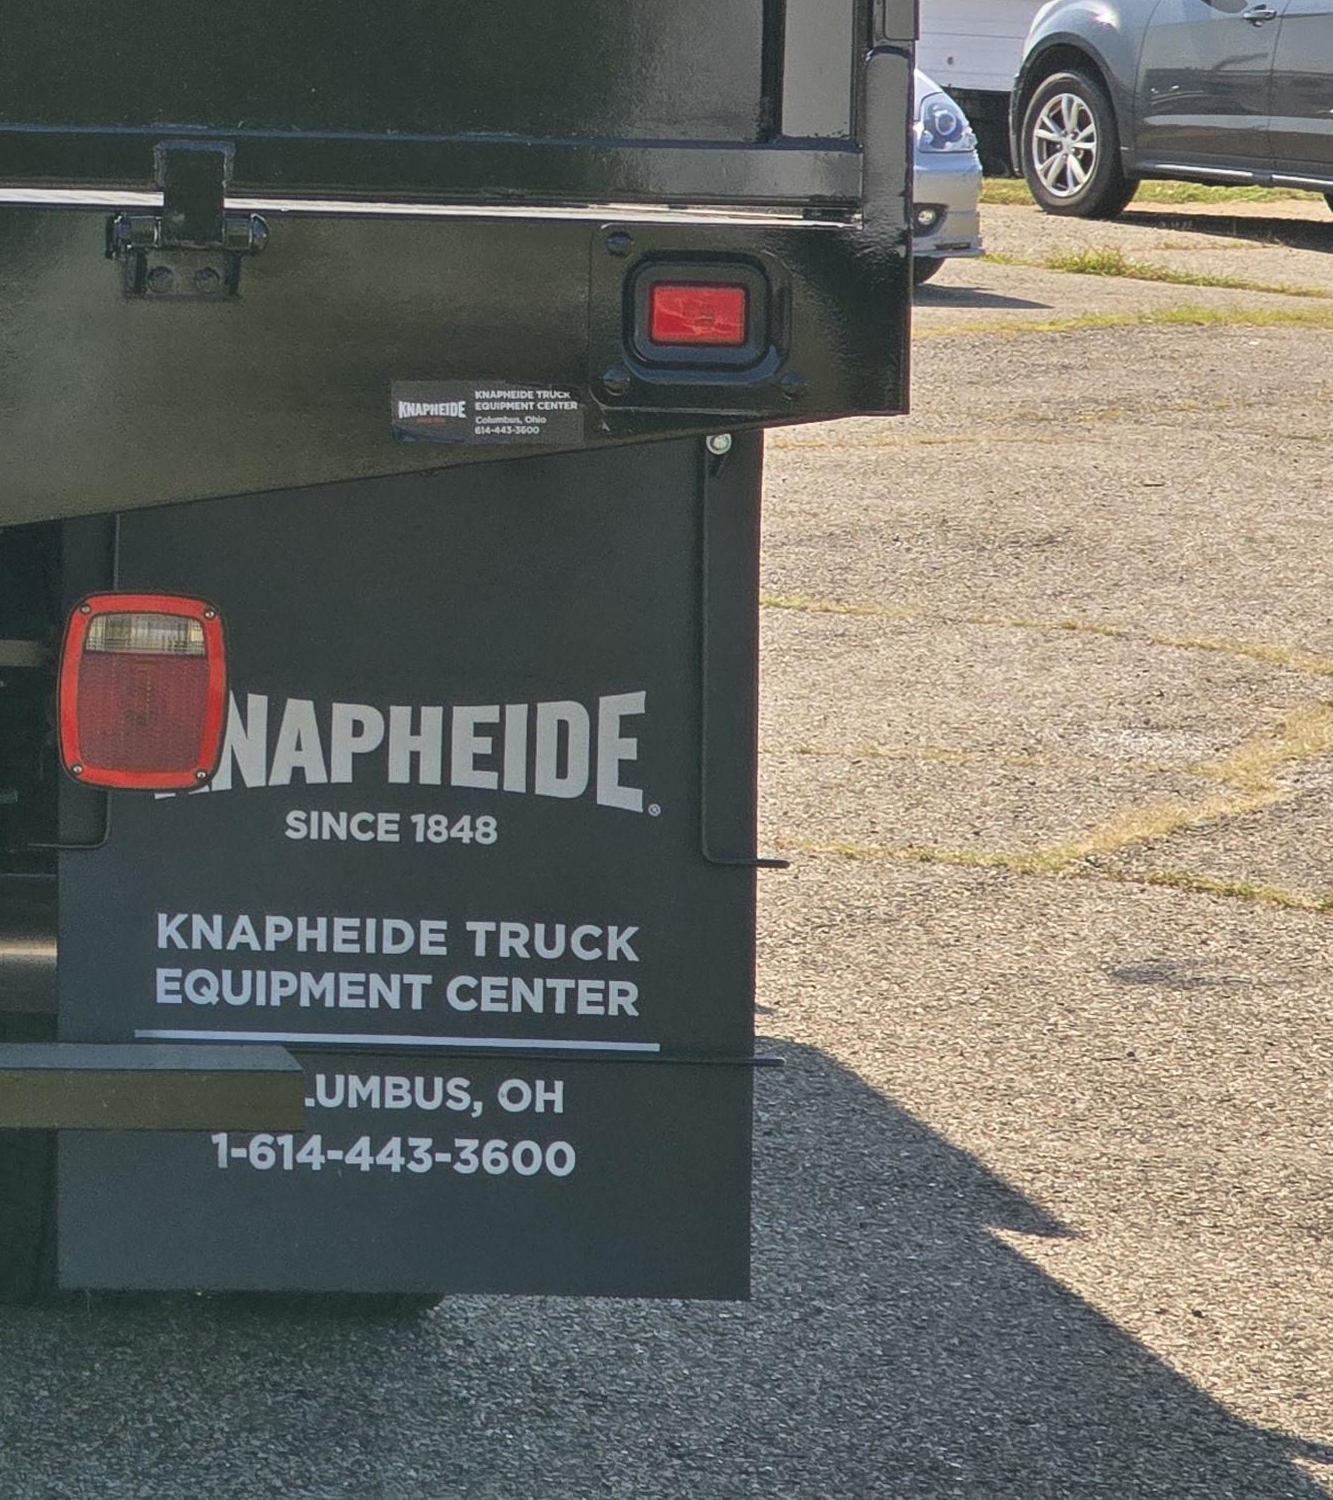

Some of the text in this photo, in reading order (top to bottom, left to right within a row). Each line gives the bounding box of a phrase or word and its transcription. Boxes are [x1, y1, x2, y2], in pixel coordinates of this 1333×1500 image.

[398, 400, 467, 419] KNAPHEIDE
[474, 390, 571, 399] KNAPHEIDE TRUCK
[474, 401, 579, 411] EQUIPMENT CENTER
[475, 425, 541, 435] 614-443-3600
[525, 415, 547, 424] Ohio
[155, 690, 646, 812] NAPHEIDE
[284, 810, 498, 845] SINCE 1848
[156, 912, 641, 962] KNAPHEIDE TRUCK
[155, 967, 641, 1017] EQUIPMENT CENTER
[304, 1073, 565, 1118] UMBUS, OH
[211, 1132, 577, 1177] 1-614-443-3600
